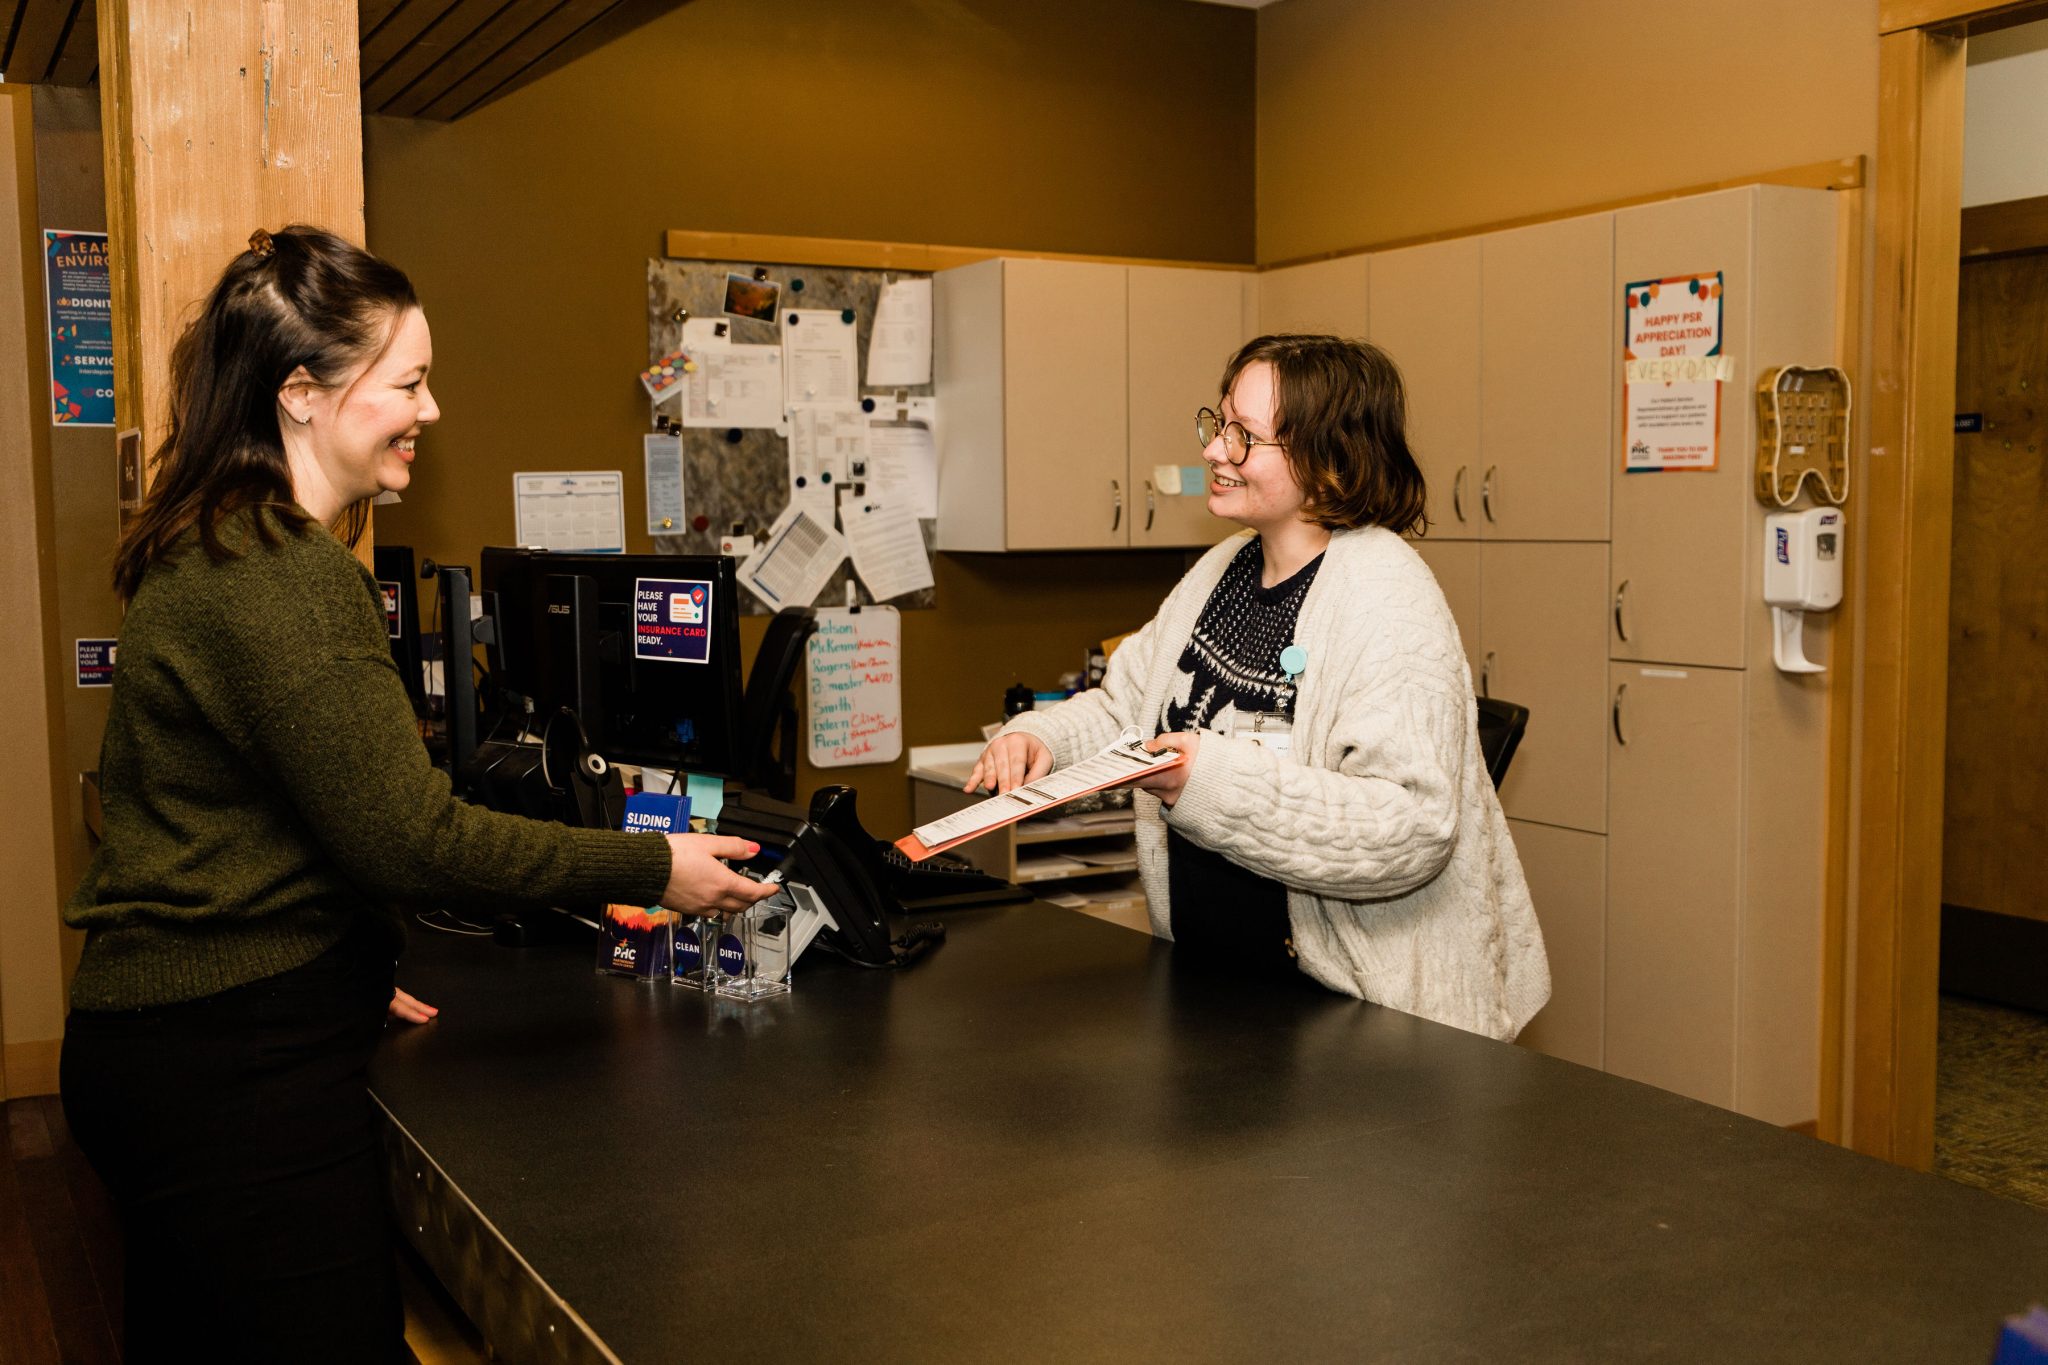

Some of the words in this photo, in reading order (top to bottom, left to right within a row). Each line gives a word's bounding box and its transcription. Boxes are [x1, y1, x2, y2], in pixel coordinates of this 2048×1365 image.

[1645, 314, 1680, 327] HAPPY
[1682, 312, 1703, 323] PSR
[1635, 327, 1712, 344] APPRECIATION
[1660, 345, 1686, 357] DAY!
[638, 591, 663, 600] PLEASE
[548, 605, 570, 614] ASUS
[638, 602, 658, 611] HAVE
[638, 613, 658, 622] YOUR
[638, 624, 681, 636] INSURANCE
[684, 628, 706, 637] CARD
[817, 619, 853, 635] elson
[638, 635, 663, 646] READY.
[814, 732, 848, 749] Float
[627, 812, 671, 828] SLIDING
[613, 946, 636, 960] PHC
[675, 942, 700, 954] CLEAN
[720, 948, 743, 960] DIRTY
